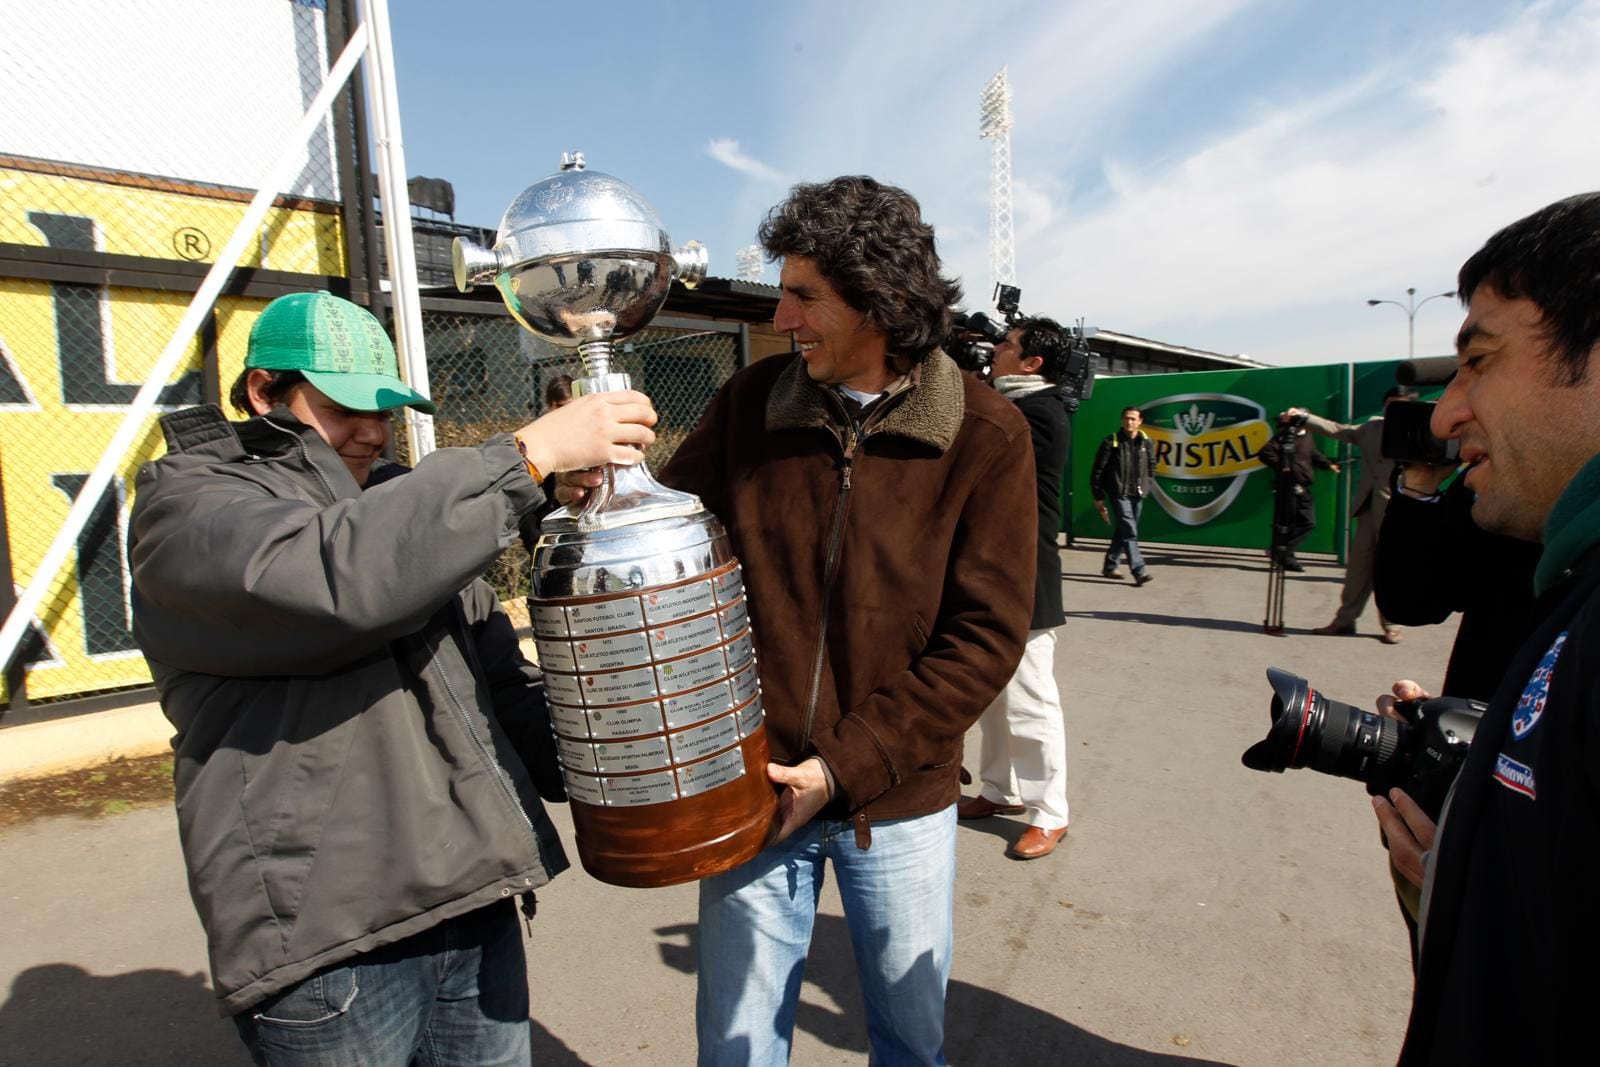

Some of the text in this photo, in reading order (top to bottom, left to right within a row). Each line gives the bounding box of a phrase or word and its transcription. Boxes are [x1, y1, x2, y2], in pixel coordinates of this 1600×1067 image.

[1153, 435, 1263, 468] RISTAL
[1171, 485, 1214, 493] CERVEZA
[1496, 756, 1536, 789] Nationwi
